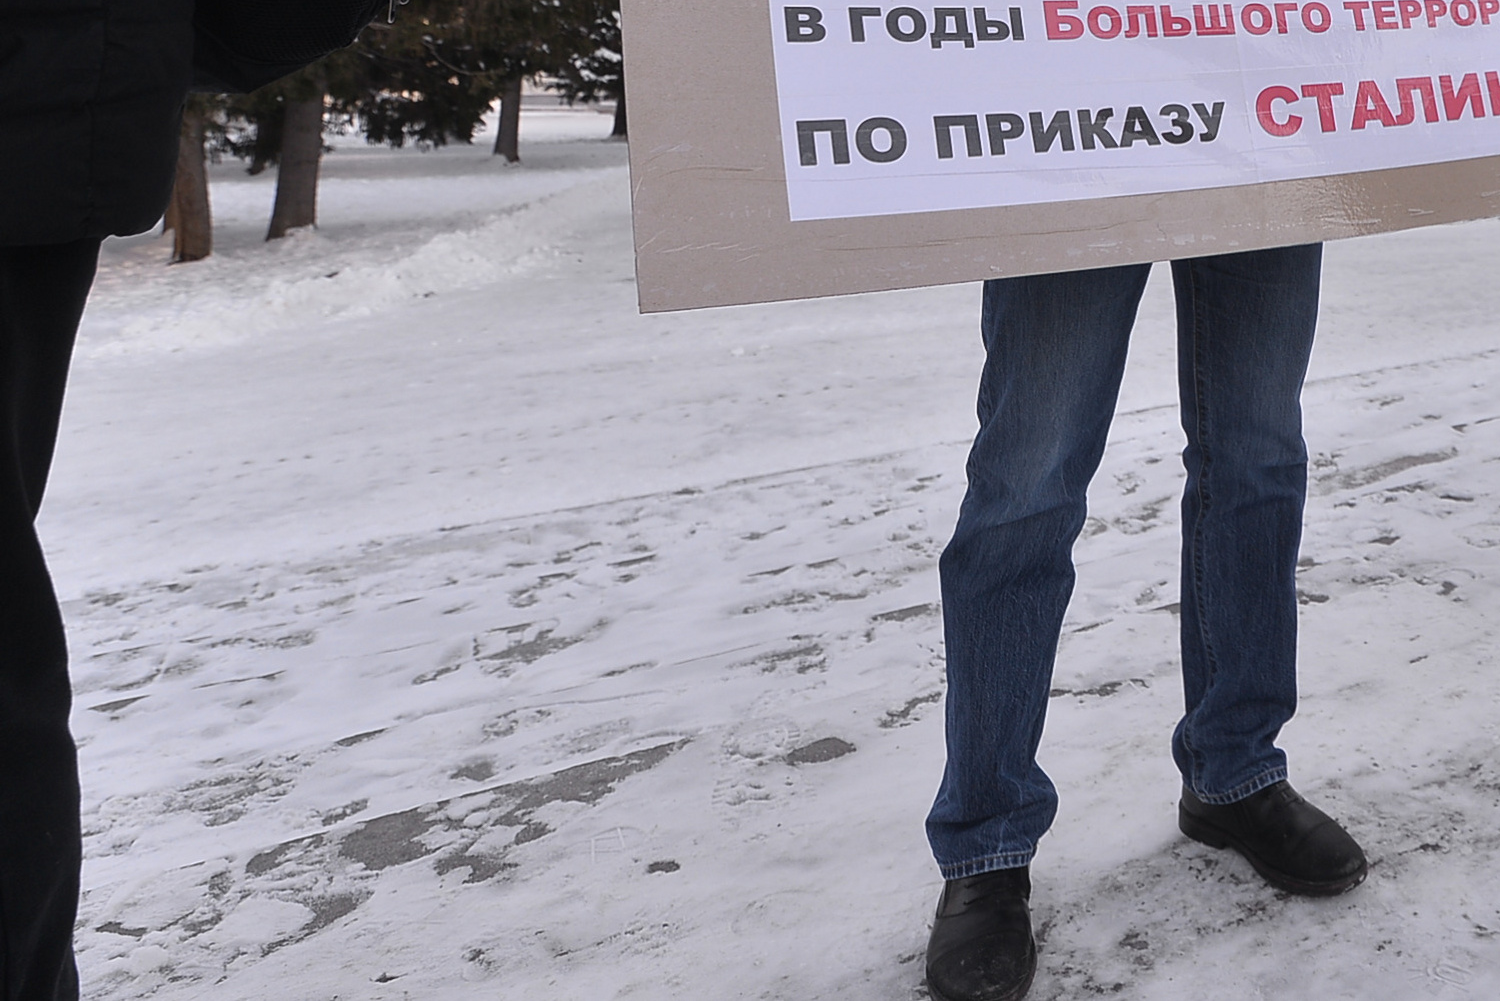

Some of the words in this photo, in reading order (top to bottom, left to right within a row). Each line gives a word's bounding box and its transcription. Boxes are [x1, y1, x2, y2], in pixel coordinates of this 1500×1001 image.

[783, 6, 827, 43] В
[848, 6, 1025, 49] ГОДЫ
[795, 116, 907, 167] ПО
[932, 101, 1225, 159] ПРИКАЗУ
